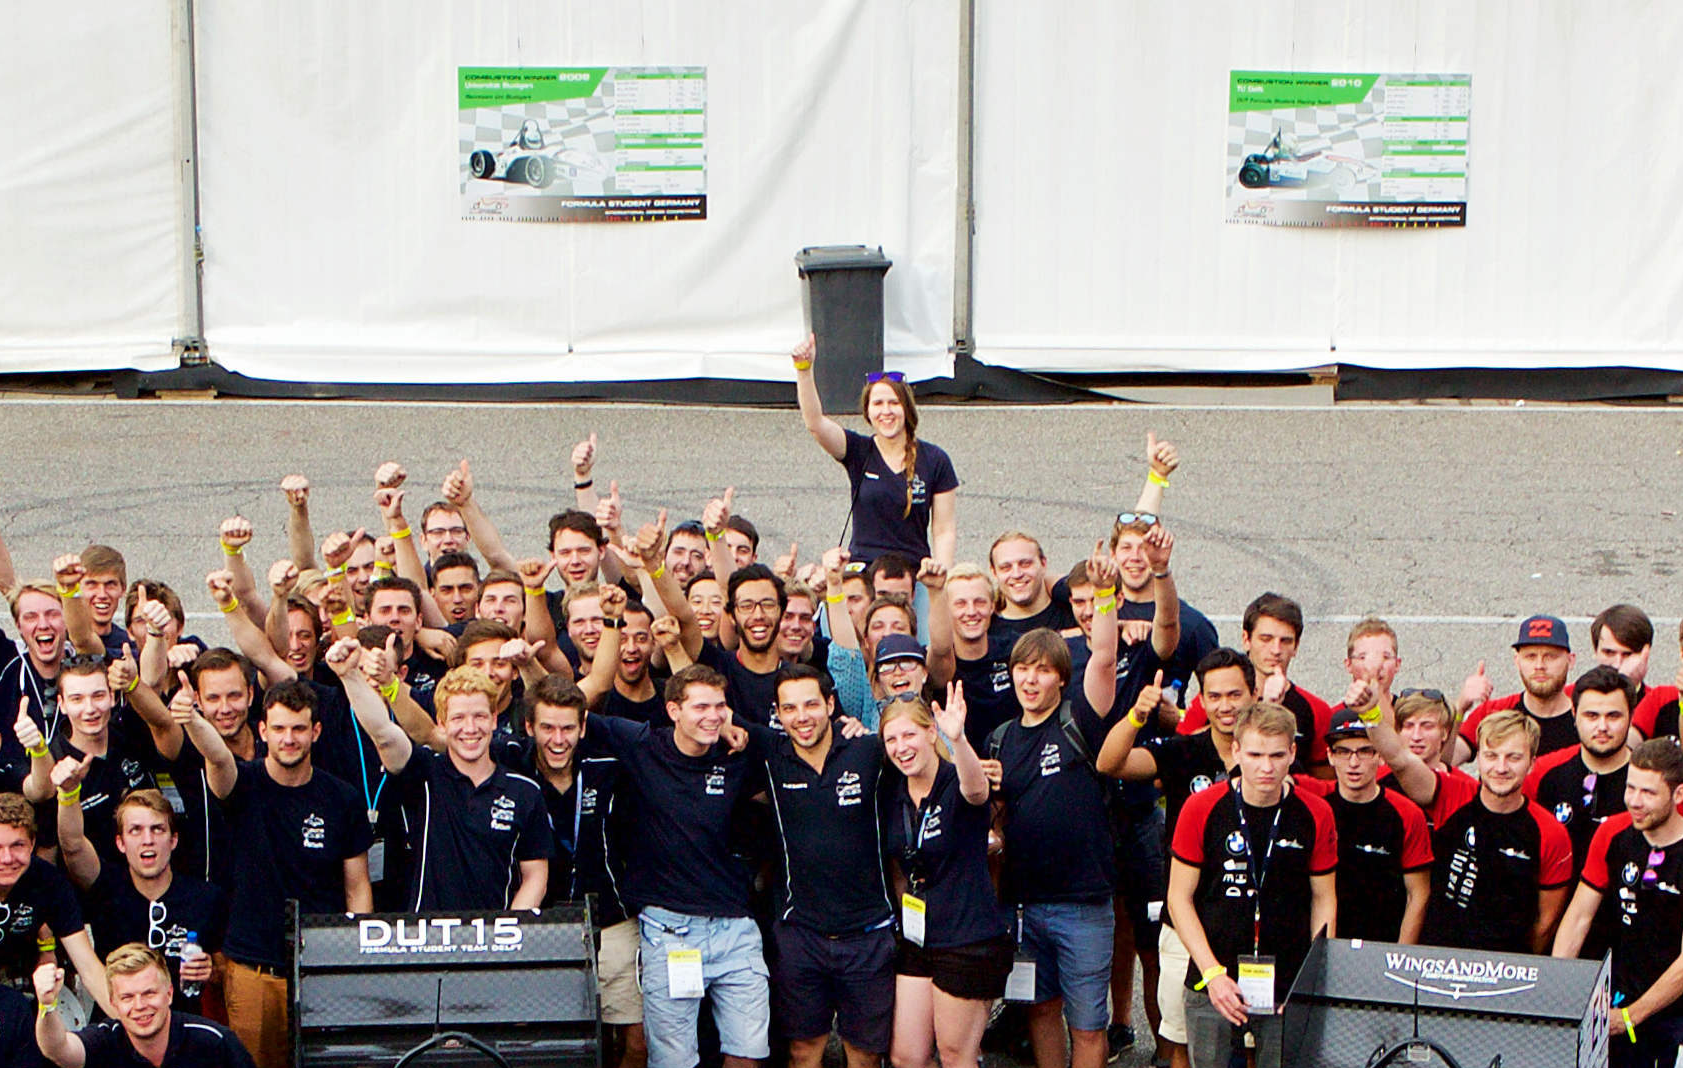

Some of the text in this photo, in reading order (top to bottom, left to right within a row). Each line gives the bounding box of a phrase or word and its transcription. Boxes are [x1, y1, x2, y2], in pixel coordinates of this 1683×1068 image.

[561, 200, 701, 208] FORMULA STUDENT GERMANY
[1326, 206, 1462, 214] FORMULA STUDENT GERMANY
[360, 943, 524, 954] FORMULA STUDENT TEAM DELFT
